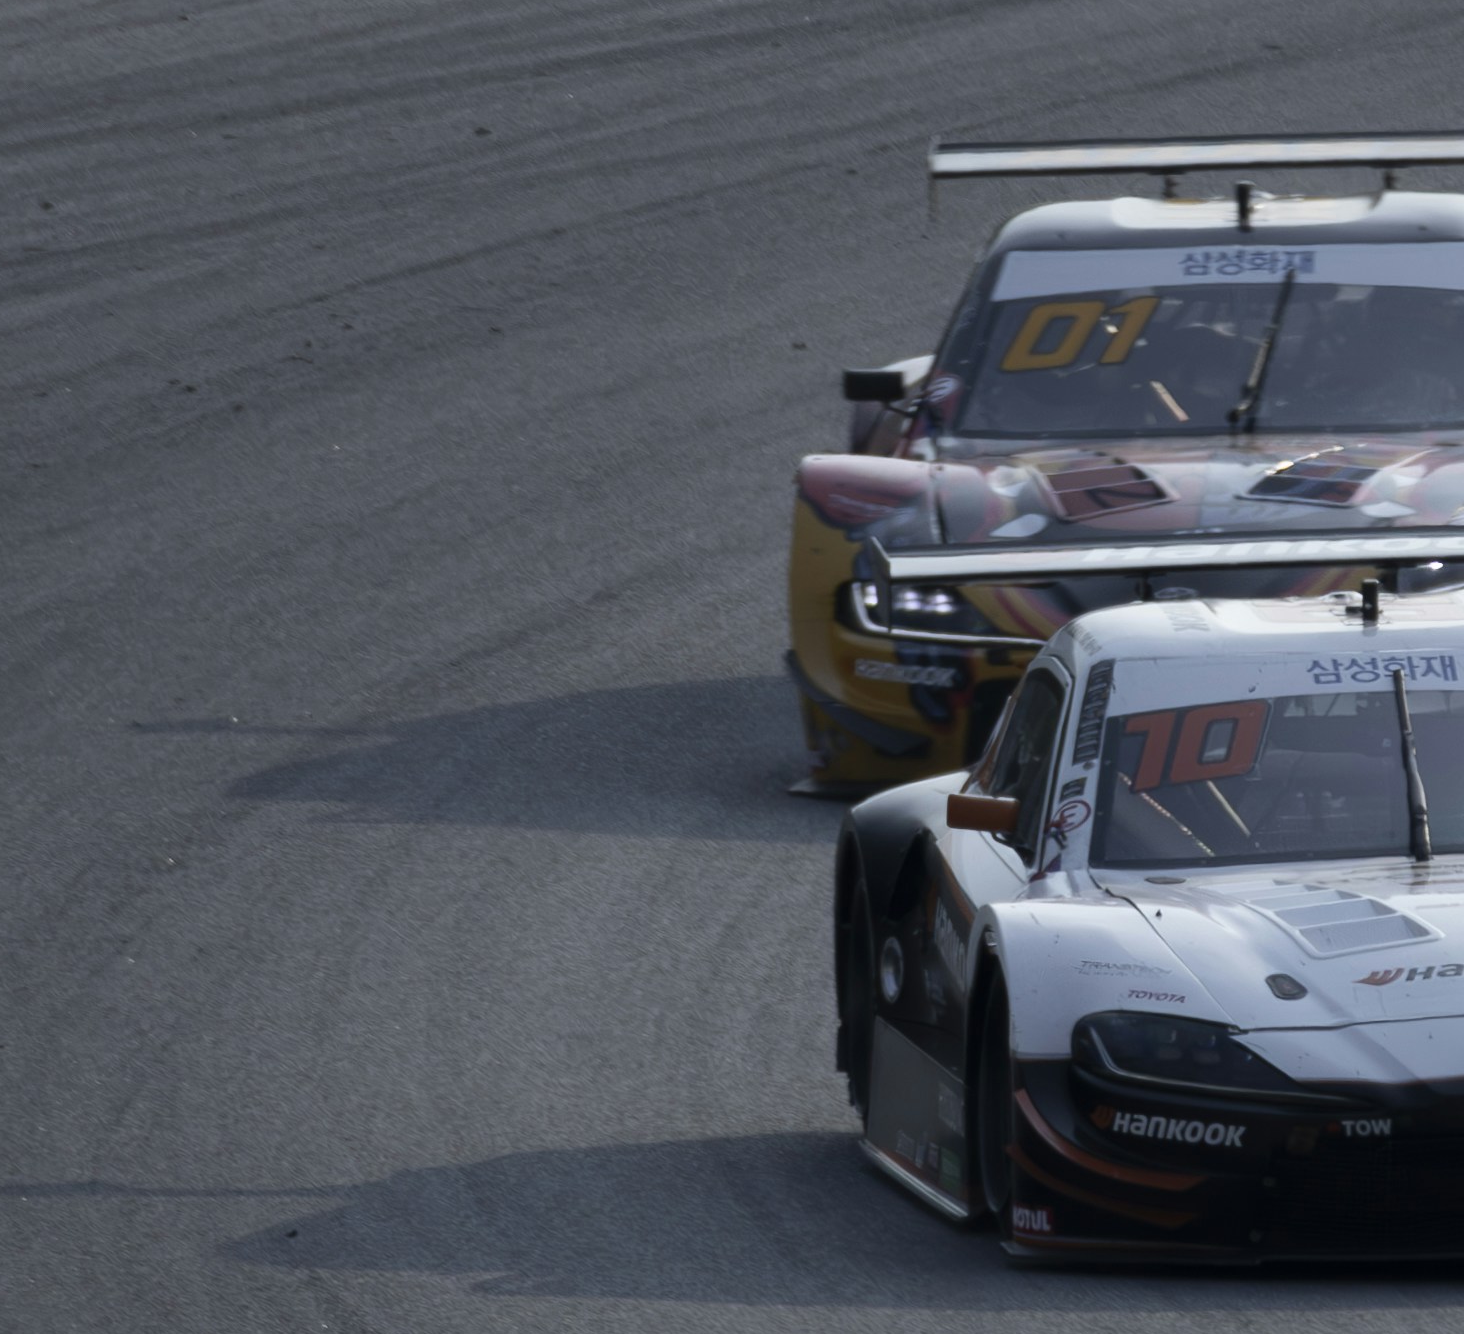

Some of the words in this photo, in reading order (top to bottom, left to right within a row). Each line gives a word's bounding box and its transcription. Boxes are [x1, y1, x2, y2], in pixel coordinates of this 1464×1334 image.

[999, 295, 1162, 373] 01
[1307, 655, 1459, 685] 삼성화재
[1124, 699, 1272, 795] 10
[1127, 989, 1187, 1004] TOYOTA
[1340, 1118, 1392, 1138] TOW
